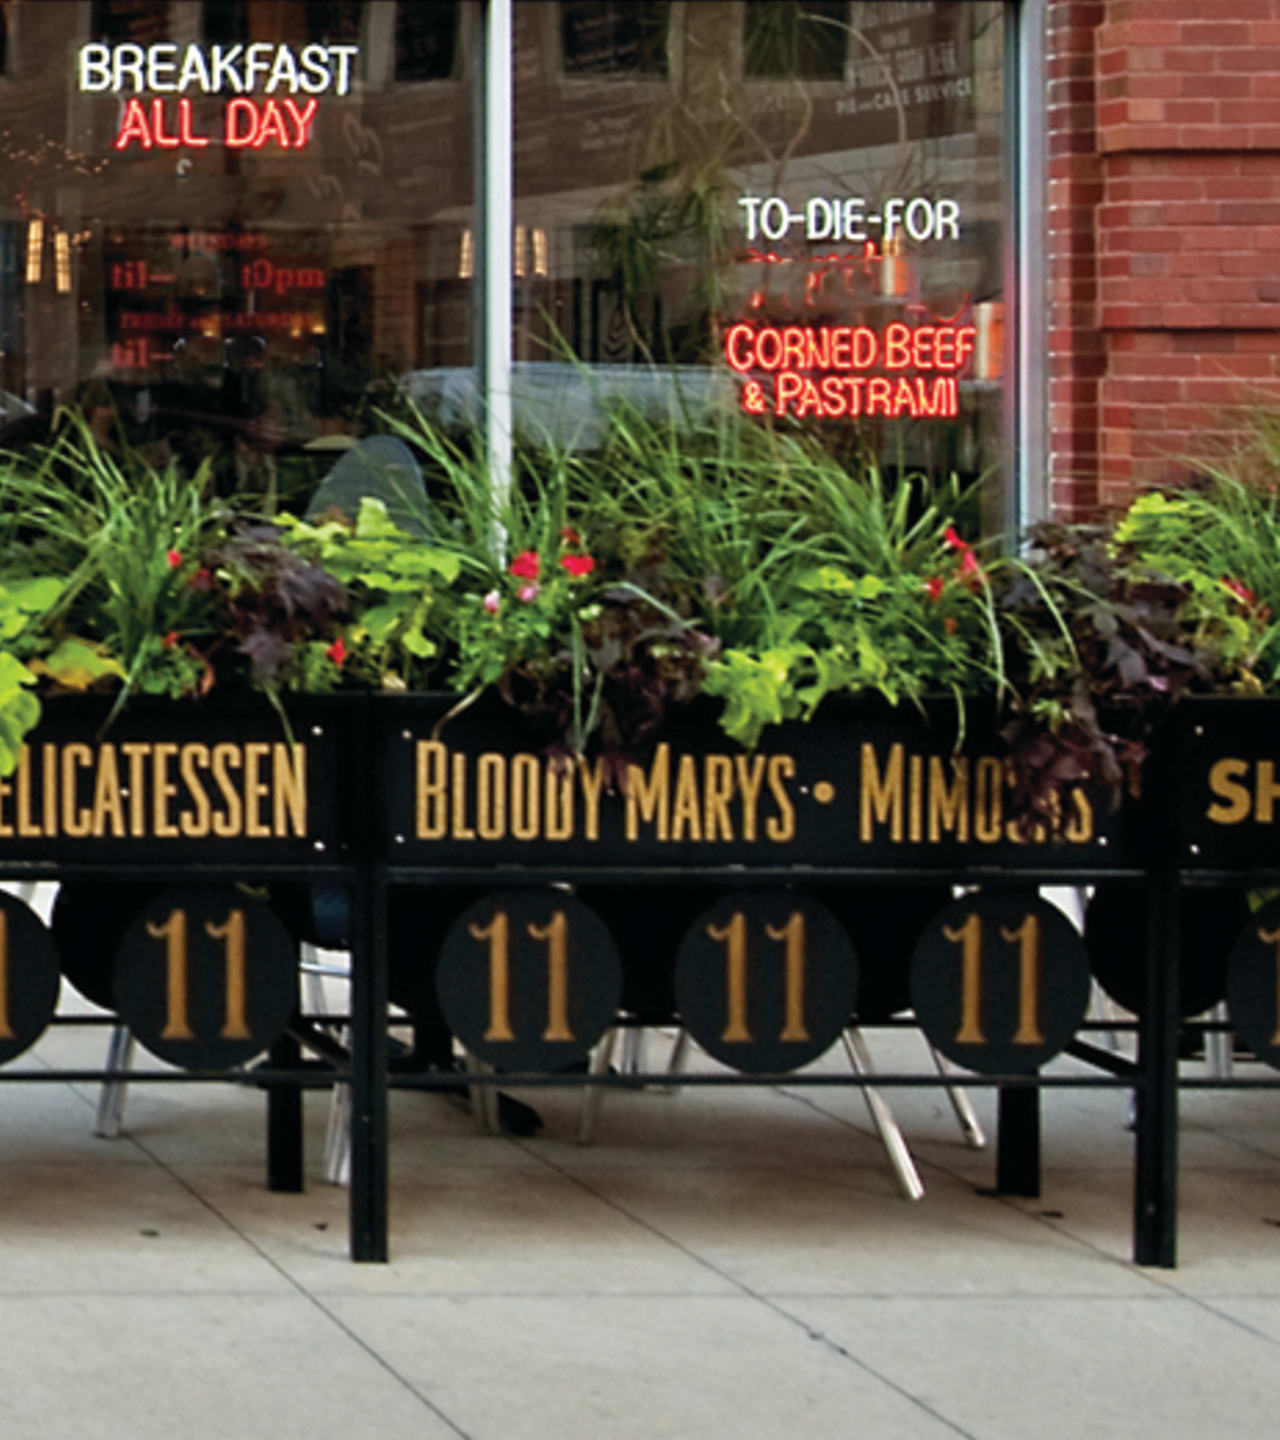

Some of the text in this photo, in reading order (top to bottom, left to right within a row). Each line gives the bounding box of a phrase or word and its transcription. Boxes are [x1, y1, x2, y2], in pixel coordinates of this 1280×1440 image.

[78, 42, 358, 96] BREAKFAST
[115, 97, 319, 150] ALL DAY
[738, 196, 961, 241] TO-DIE-FOR
[724, 321, 977, 370] CORNED BEEF
[744, 371, 959, 417] & PASTRAMI
[415, 738, 1094, 844] BLOODY MARYS MIMOS
[144, 907, 253, 1040] 11
[469, 910, 575, 1043] 11
[705, 911, 813, 1044] 11
[942, 912, 1045, 1045] 11
